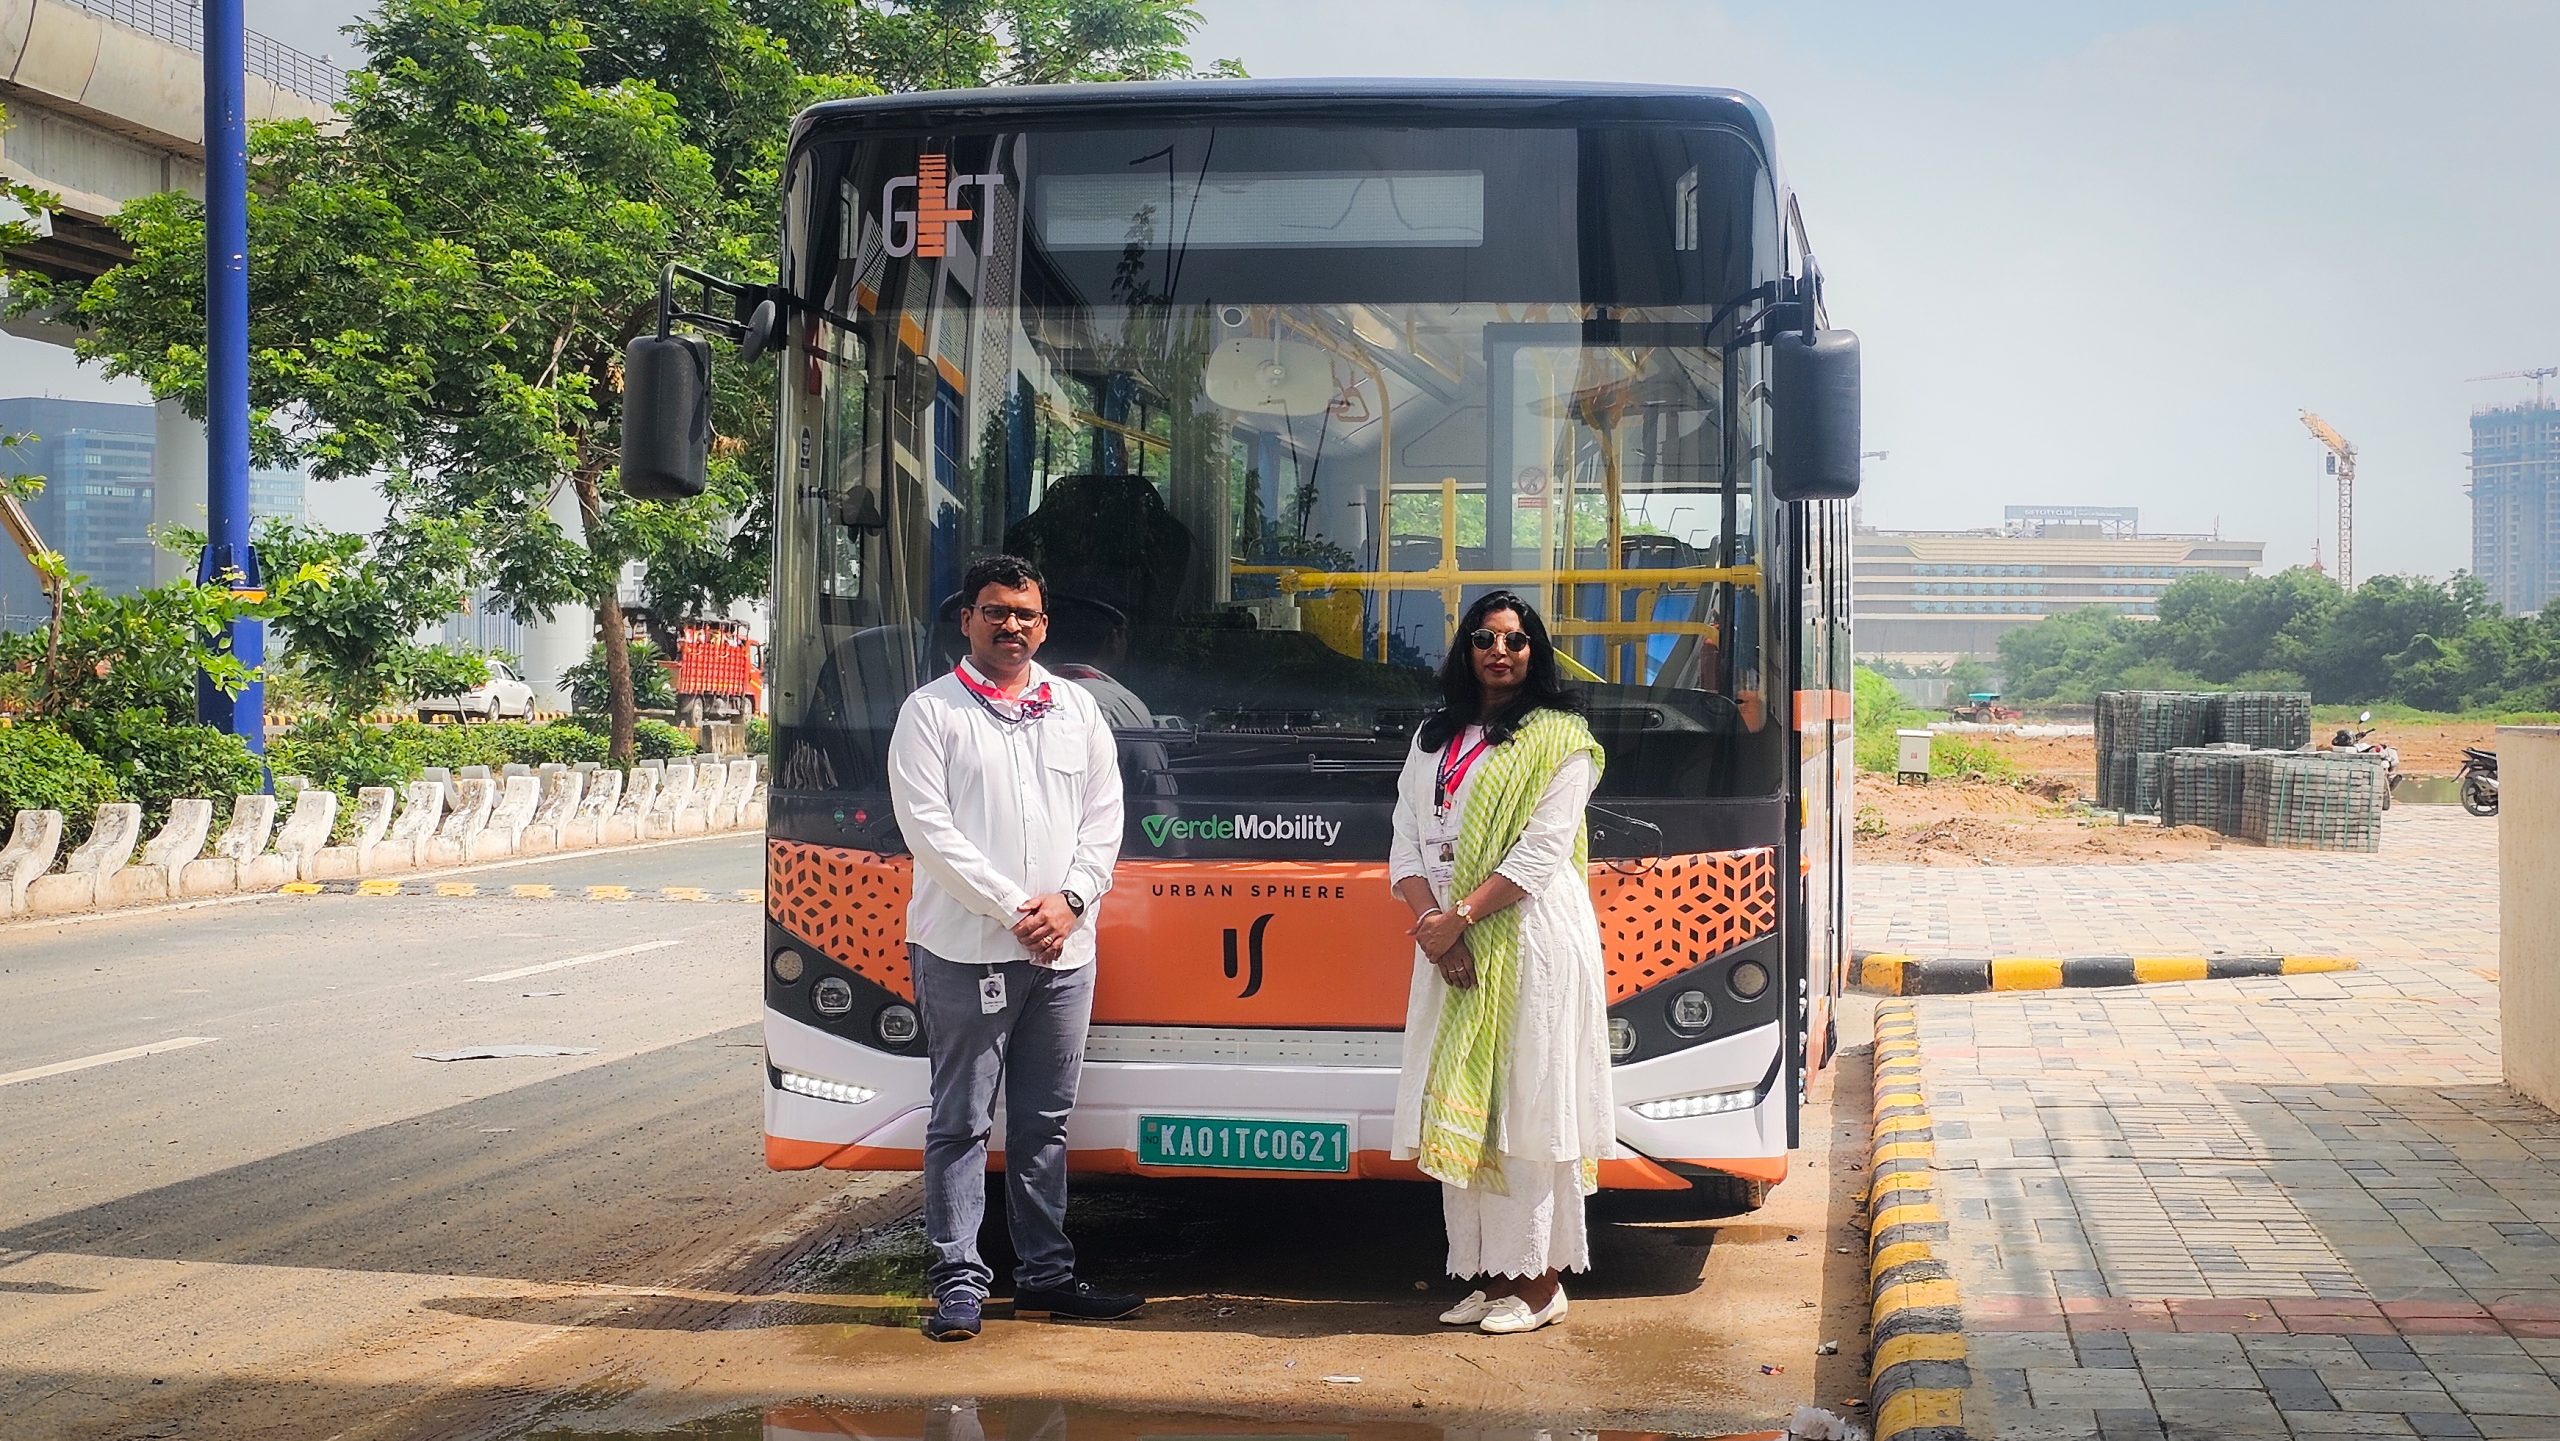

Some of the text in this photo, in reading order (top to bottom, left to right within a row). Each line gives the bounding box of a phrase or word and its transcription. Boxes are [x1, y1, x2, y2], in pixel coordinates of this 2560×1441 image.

[882, 154, 1004, 258] GIFT
[1141, 814, 1342, 848] VerdeMobility
[1152, 884, 1345, 899] URBAN SPHERE
[1143, 1135, 1159, 1145] IND
[1161, 1124, 1342, 1163] KA01TC0621
